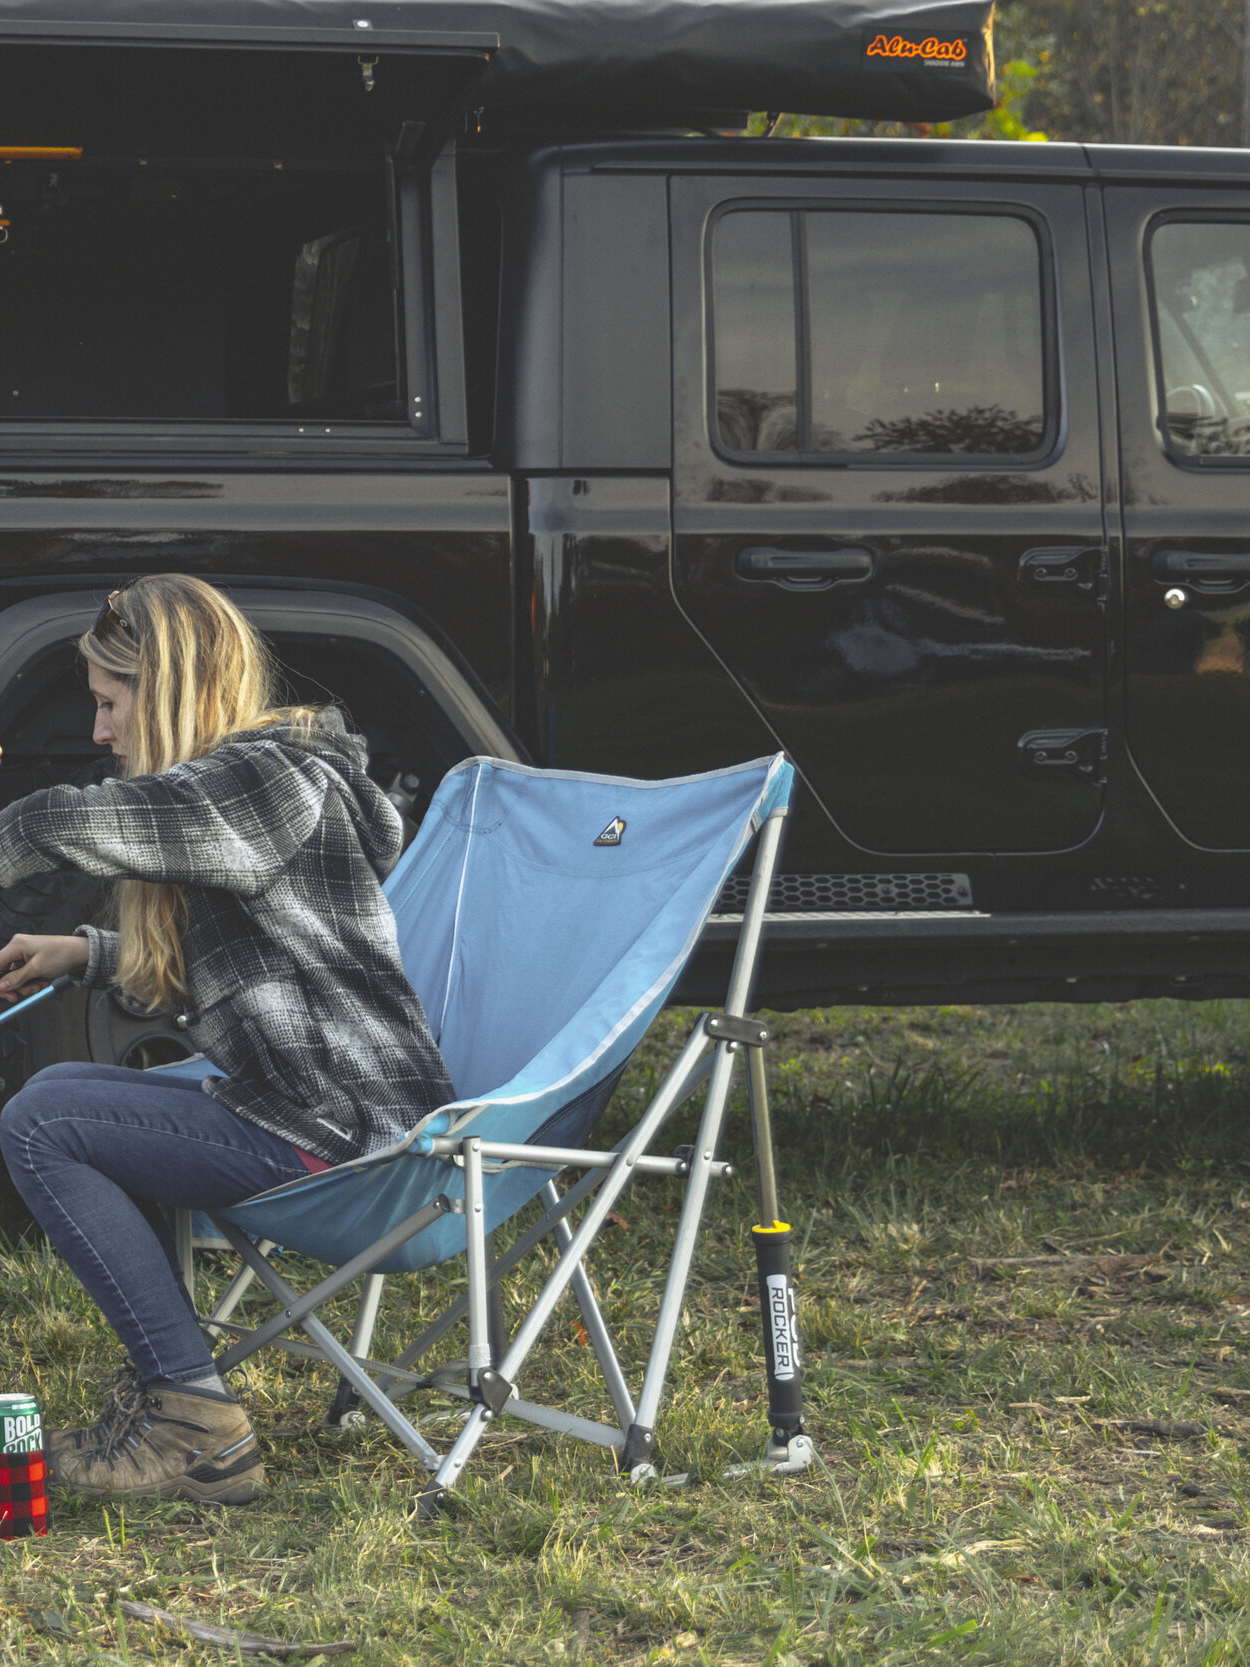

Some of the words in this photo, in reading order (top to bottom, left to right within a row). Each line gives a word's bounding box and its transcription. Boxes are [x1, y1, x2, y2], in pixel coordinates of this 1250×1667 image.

[867, 35, 966, 60] Alu-Cab
[771, 1287, 790, 1367] ROCKER
[4, 1413, 40, 1443] BOLD
